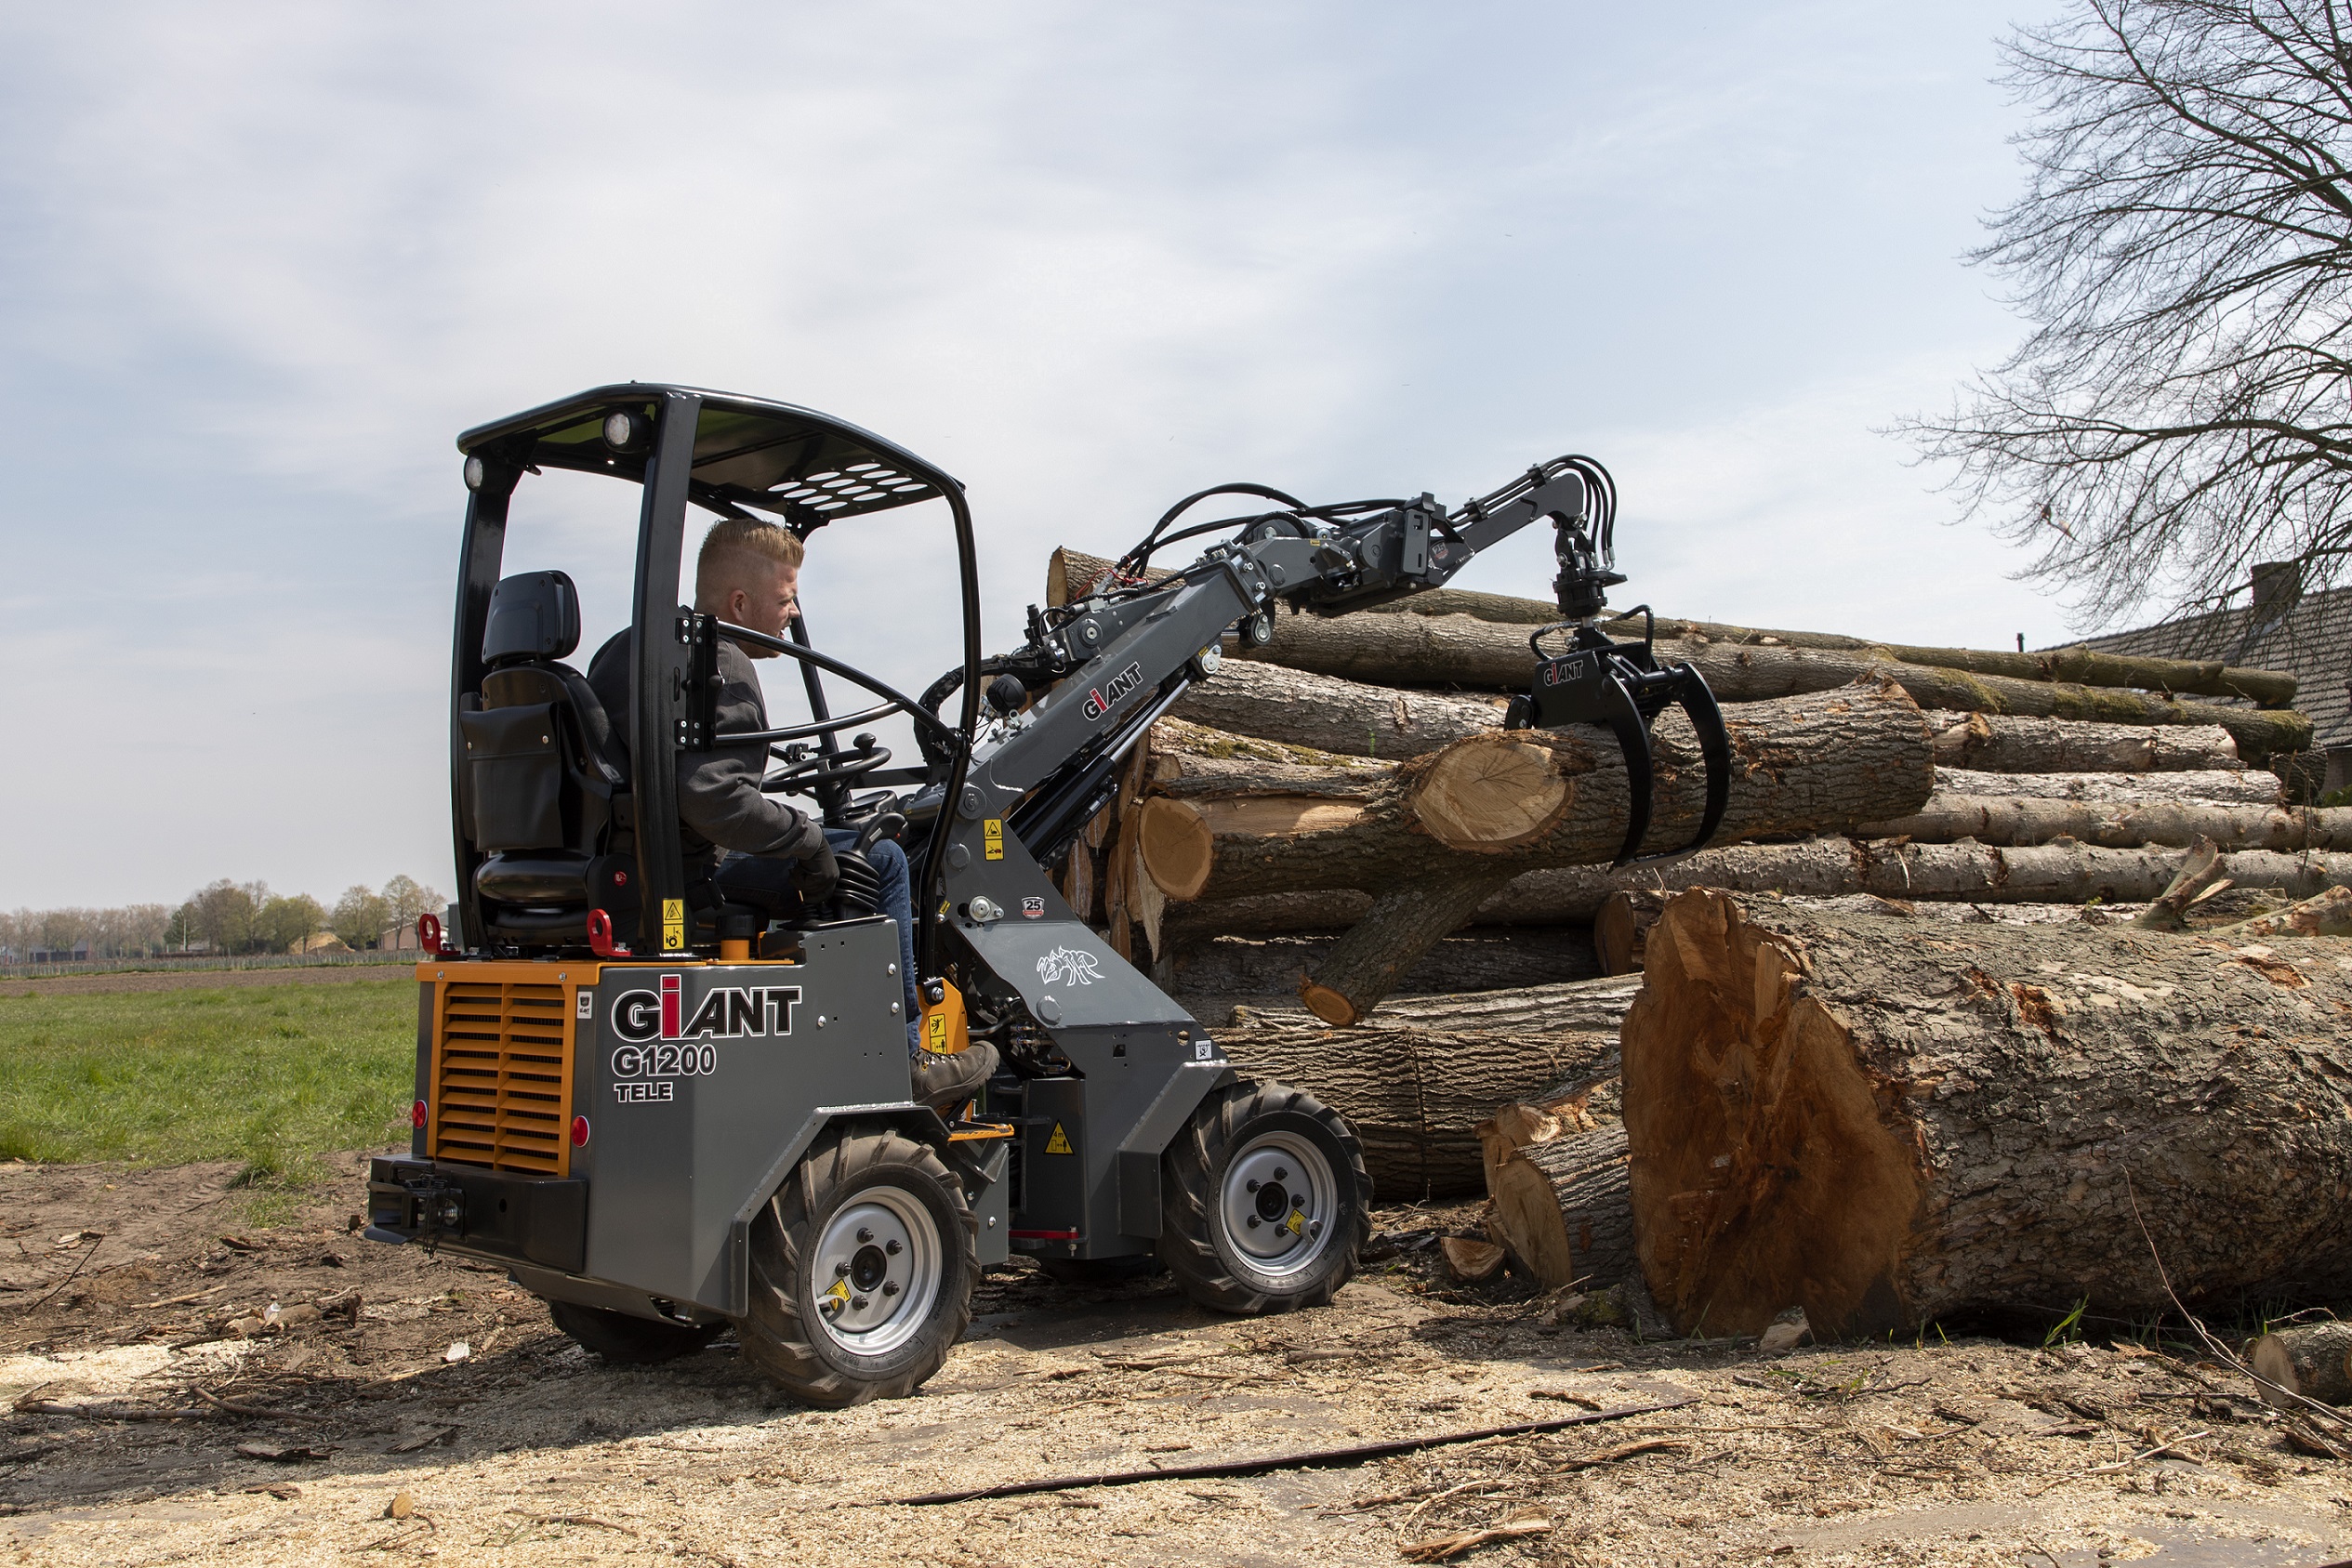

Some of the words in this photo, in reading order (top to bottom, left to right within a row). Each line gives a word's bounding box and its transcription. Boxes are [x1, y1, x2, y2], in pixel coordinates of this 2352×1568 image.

[1026, 901, 1041, 911] 25
[611, 1044, 717, 1078] G1200
[614, 1081, 673, 1103] TELE
